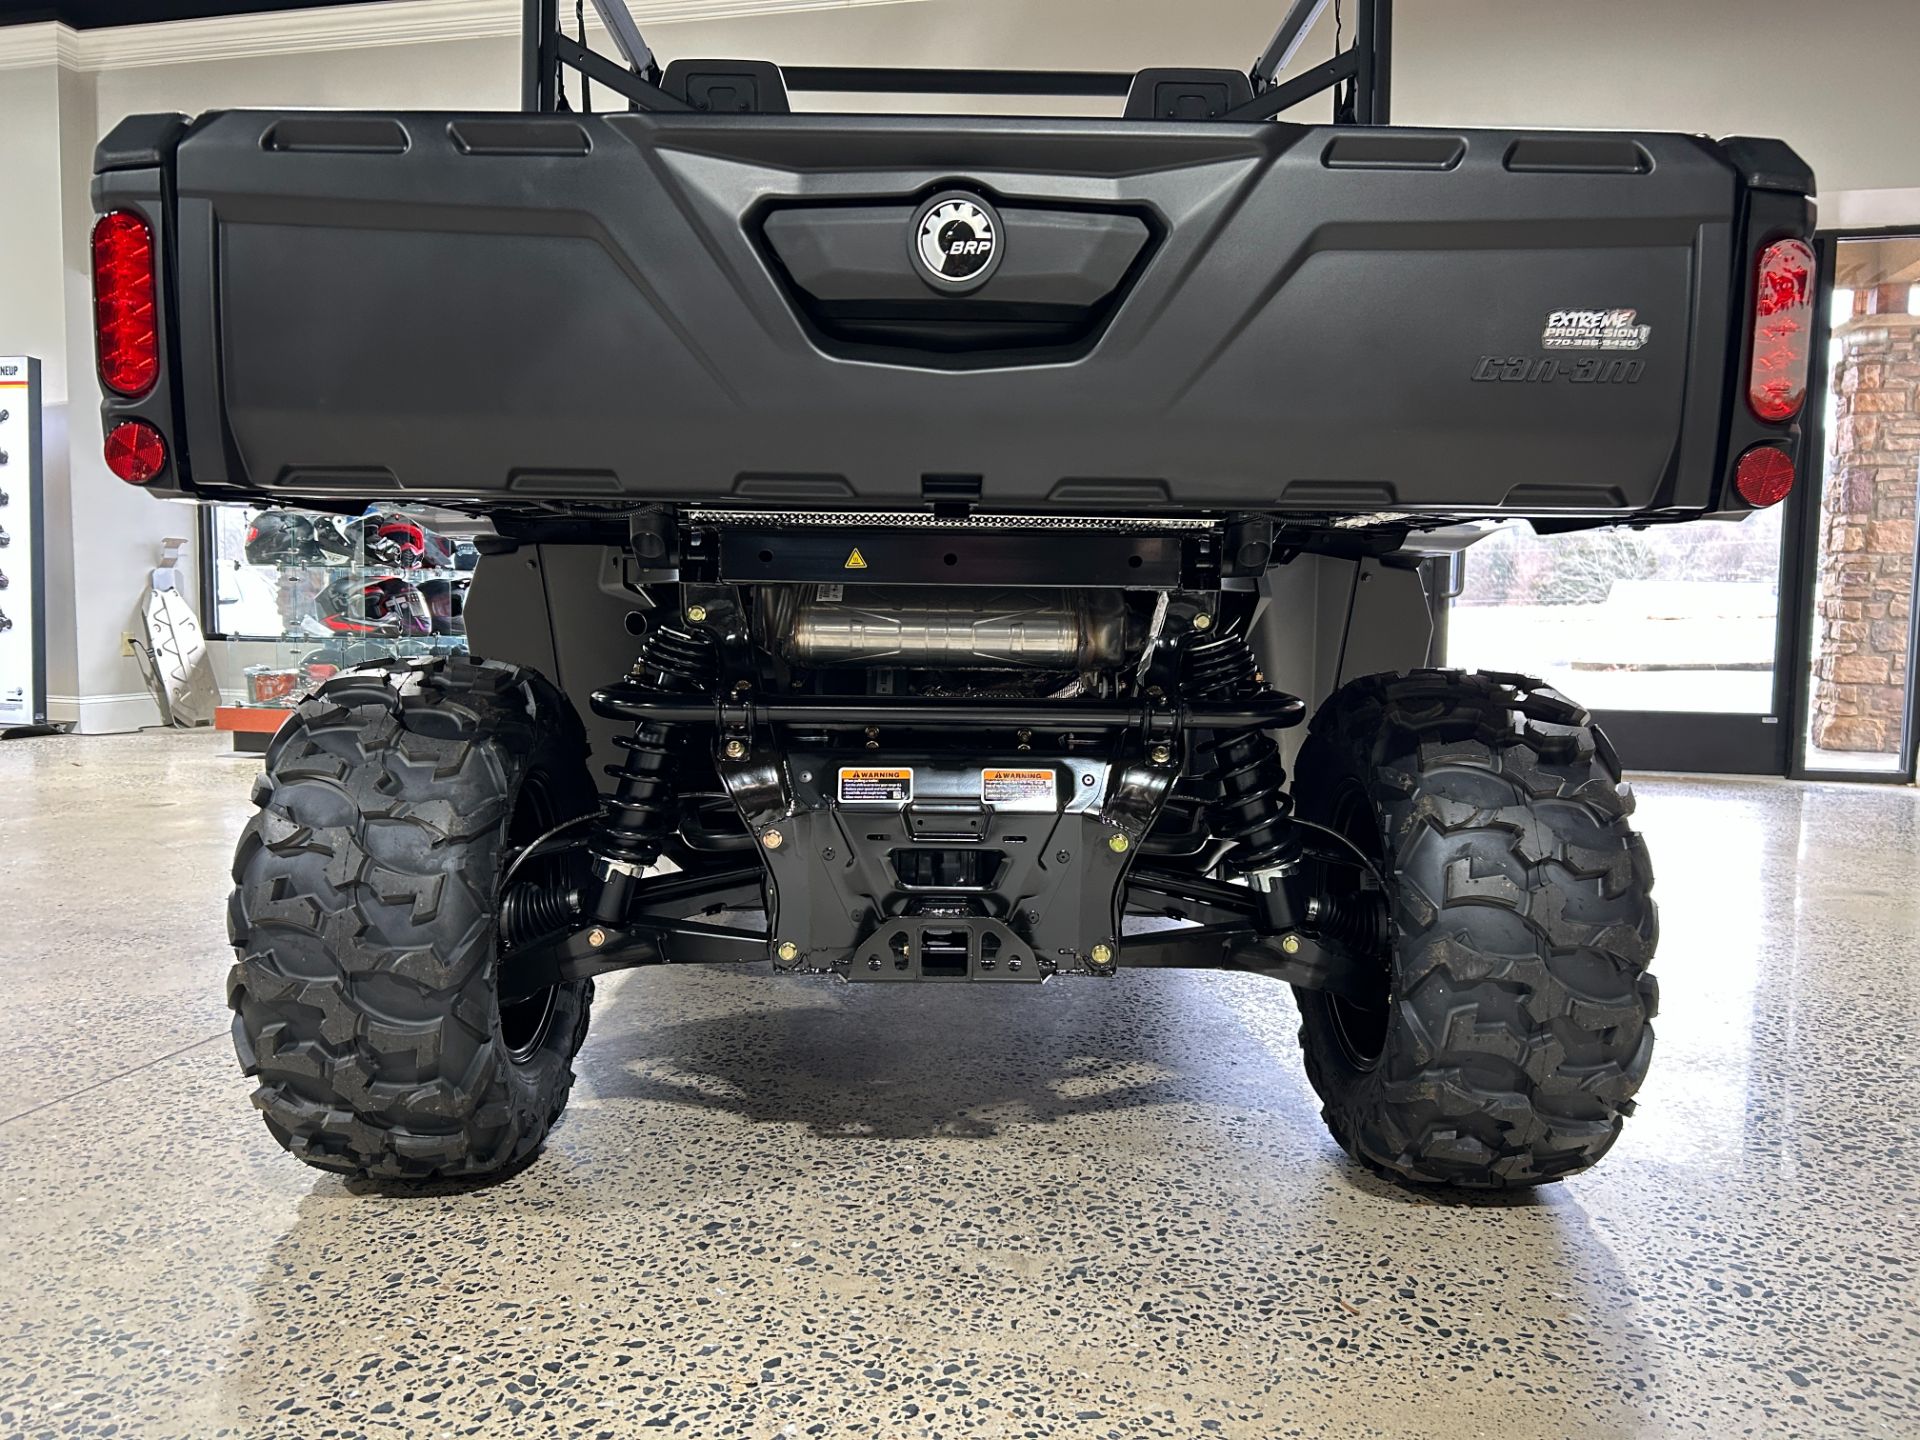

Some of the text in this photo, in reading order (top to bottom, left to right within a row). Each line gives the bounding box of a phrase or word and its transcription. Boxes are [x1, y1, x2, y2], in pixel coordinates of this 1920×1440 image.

[949, 241, 991, 255] BRP
[1548, 311, 1631, 328] EXTREME
[1545, 327, 1639, 338] PROPULSION
